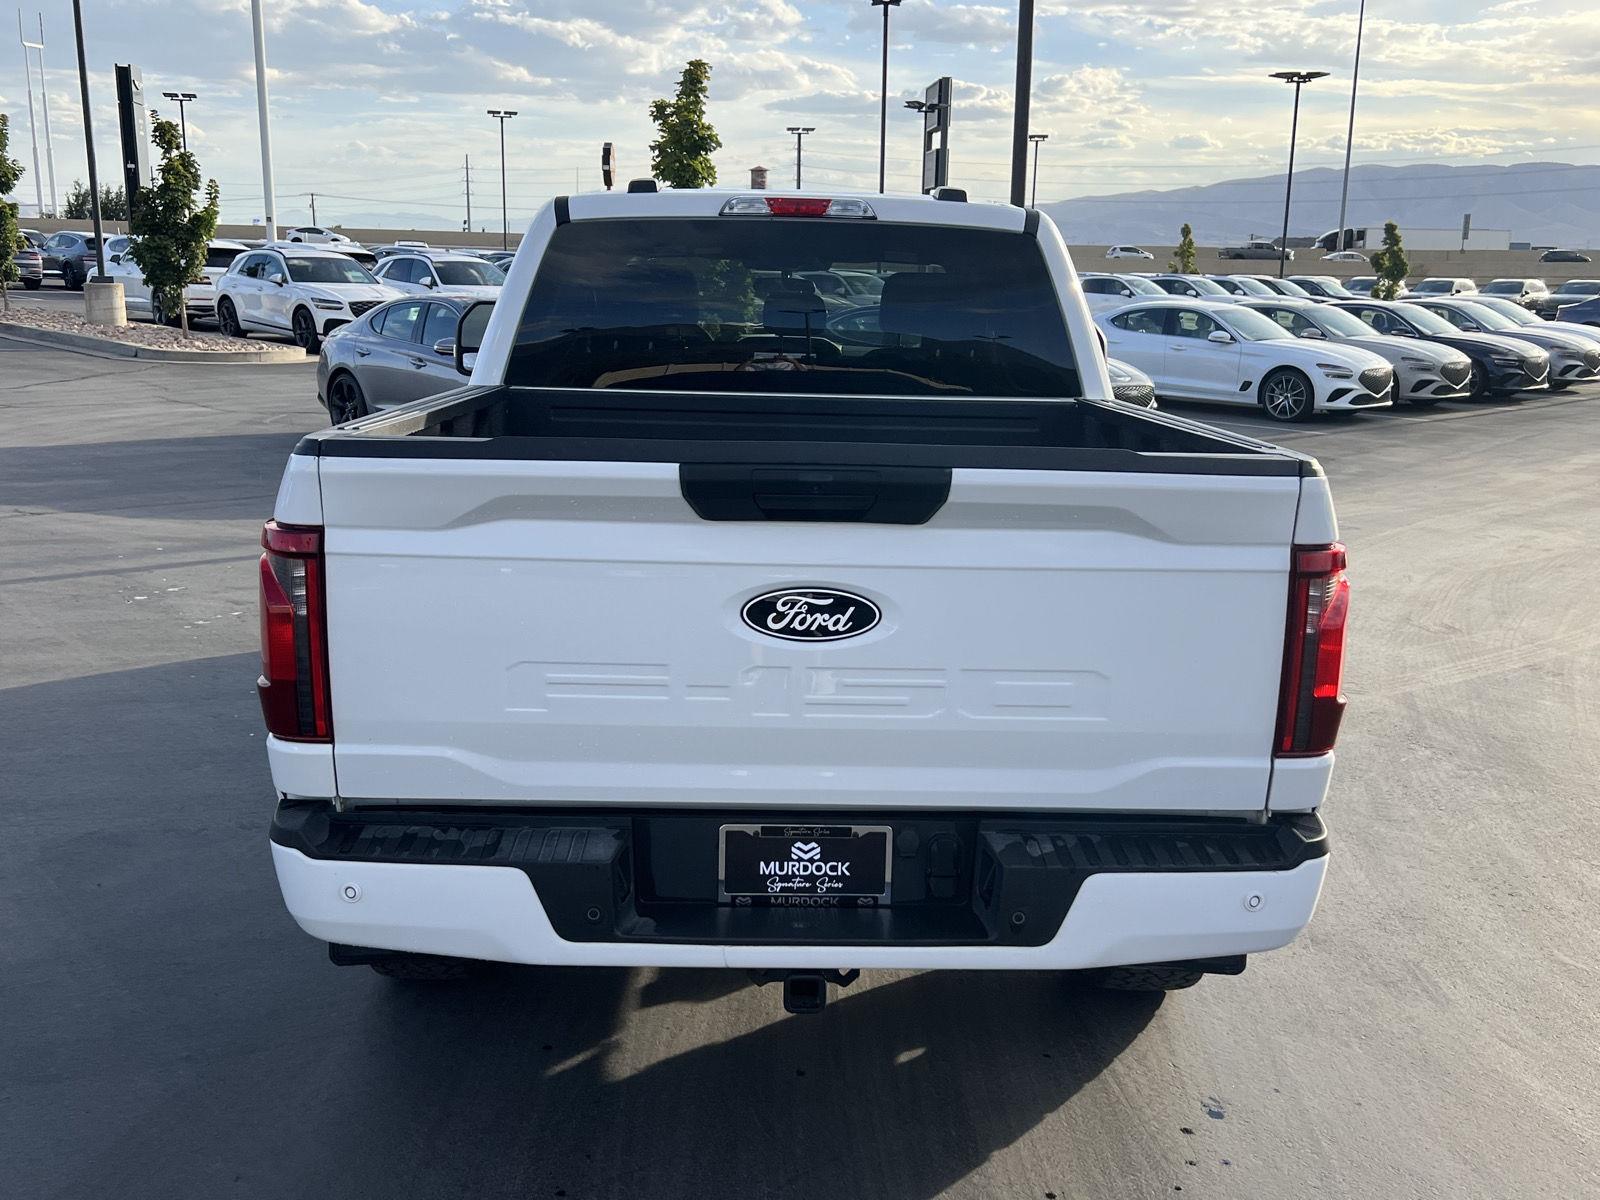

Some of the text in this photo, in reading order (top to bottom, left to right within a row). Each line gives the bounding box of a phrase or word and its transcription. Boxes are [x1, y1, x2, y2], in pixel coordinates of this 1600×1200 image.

[766, 595, 856, 632] Ford
[504, 660, 1110, 721] F-150
[759, 861, 850, 876] MURDOCK
[766, 876, 843, 893] Signature Series
[770, 896, 839, 906] MURDOCK
